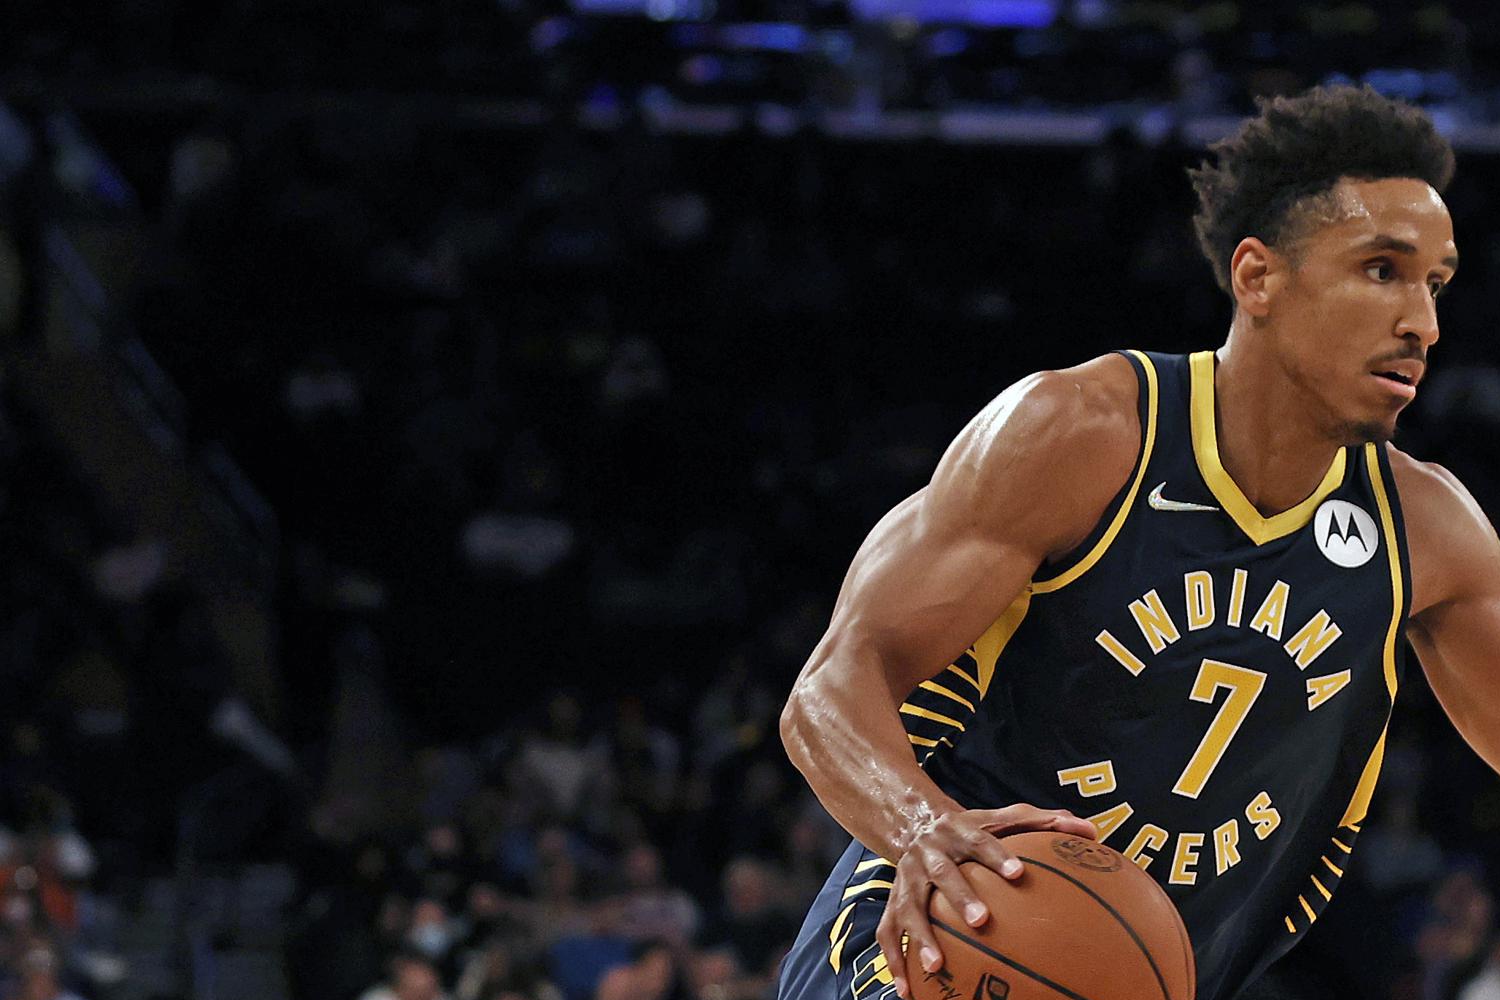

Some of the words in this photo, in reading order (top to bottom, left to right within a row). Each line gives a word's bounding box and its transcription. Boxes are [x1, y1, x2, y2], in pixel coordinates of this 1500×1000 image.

[1095, 568, 1351, 711] INDIANA
[1172, 658, 1267, 799] 7
[1057, 760, 1281, 886] PACERS
